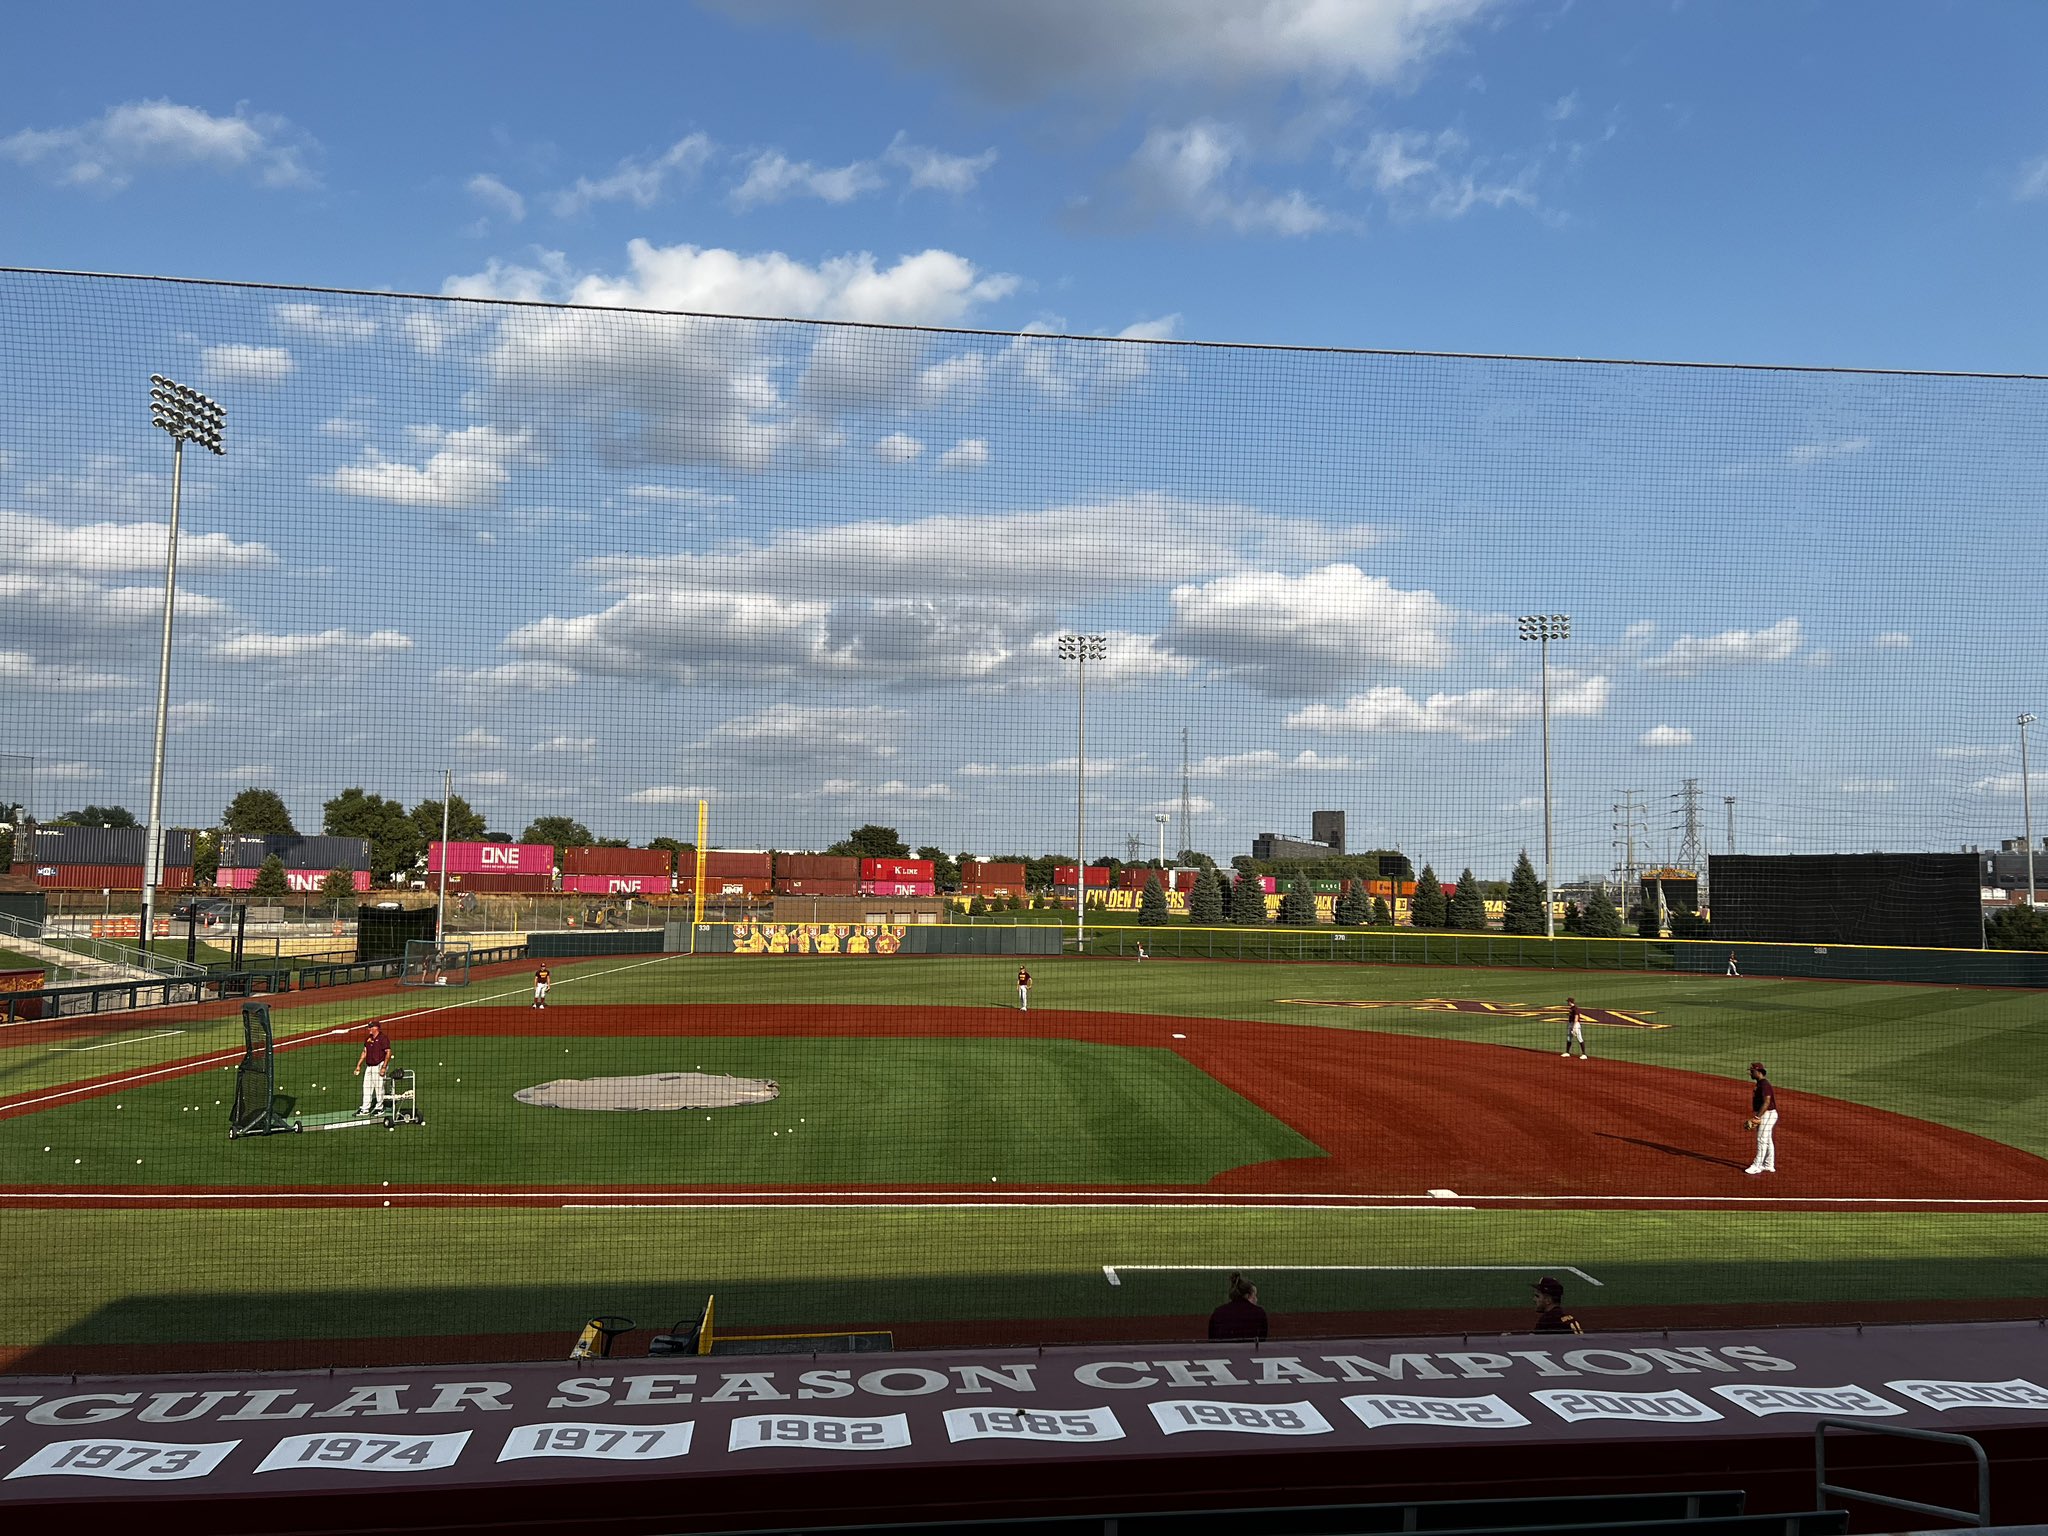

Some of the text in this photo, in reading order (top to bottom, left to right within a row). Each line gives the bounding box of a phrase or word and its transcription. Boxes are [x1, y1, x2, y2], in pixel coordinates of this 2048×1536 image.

[481, 847, 519, 864] ONE
[547, 1363, 1038, 1409] SEASON
[1073, 1345, 1797, 1390] CHAMPIONS
[51, 1384, 2048, 1474] 1973 1974 1977 1982 1985 1988 1992 2000 2002 2003
